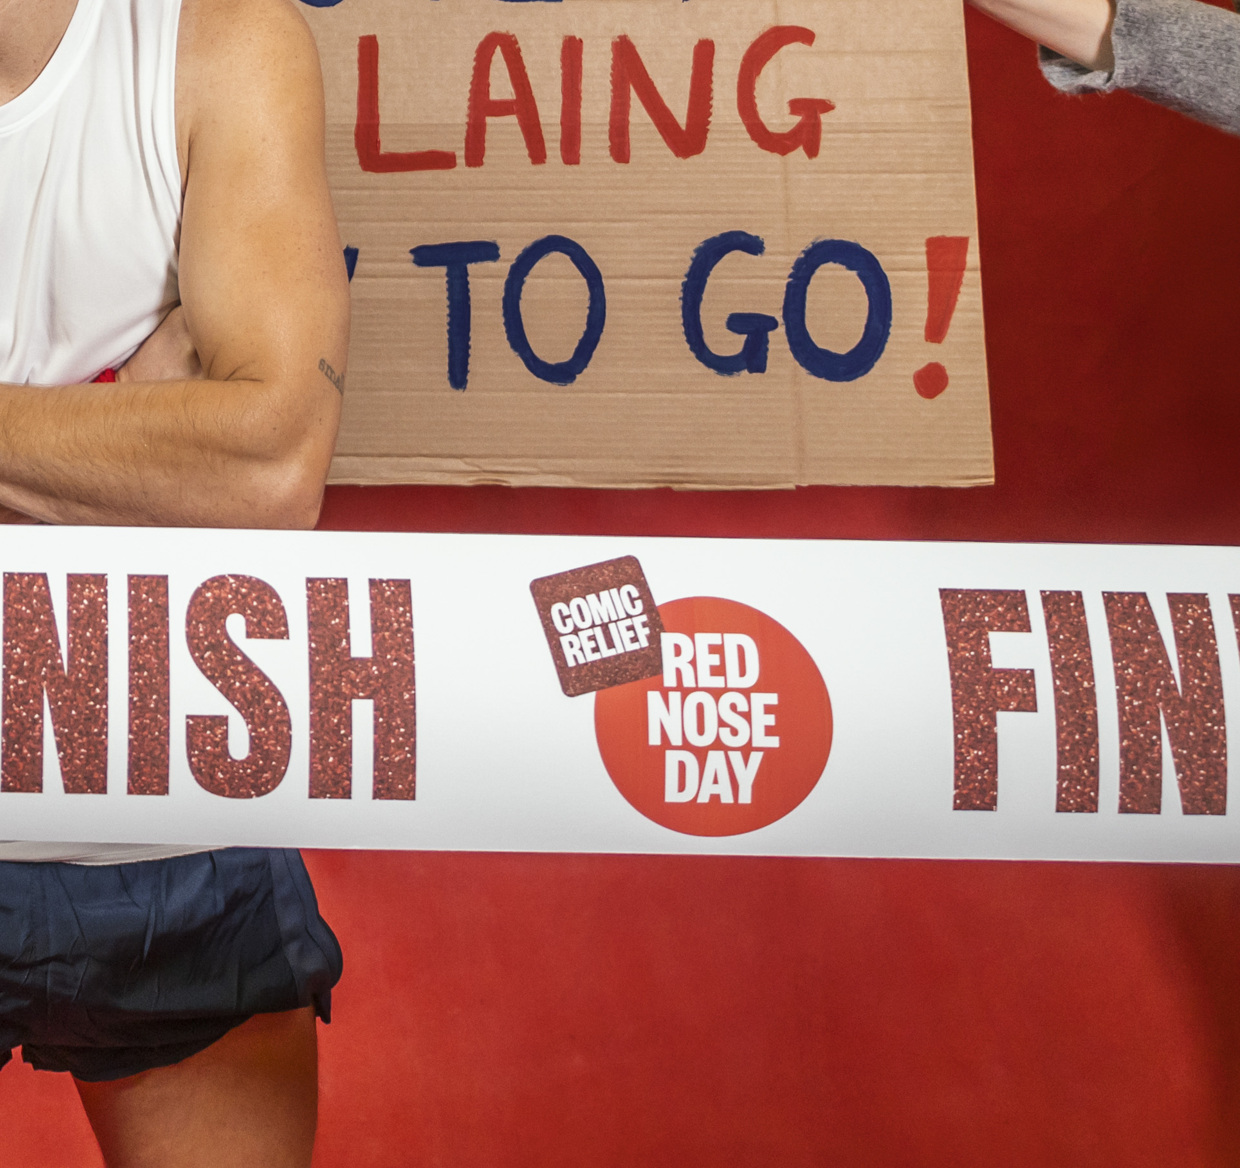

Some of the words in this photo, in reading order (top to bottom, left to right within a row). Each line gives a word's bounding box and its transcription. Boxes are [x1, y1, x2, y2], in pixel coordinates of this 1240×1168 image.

[355, 25, 836, 174] LAING
[409, 234, 607, 392] TO
[681, 230, 970, 400] GO!
[550, 584, 644, 634] COMIC
[559, 614, 651, 667] RELIEF
[660, 632, 761, 688] RED
[647, 691, 780, 748] NOSE
[938, 588, 1240, 816] FIN
[664, 750, 765, 804] DAY
